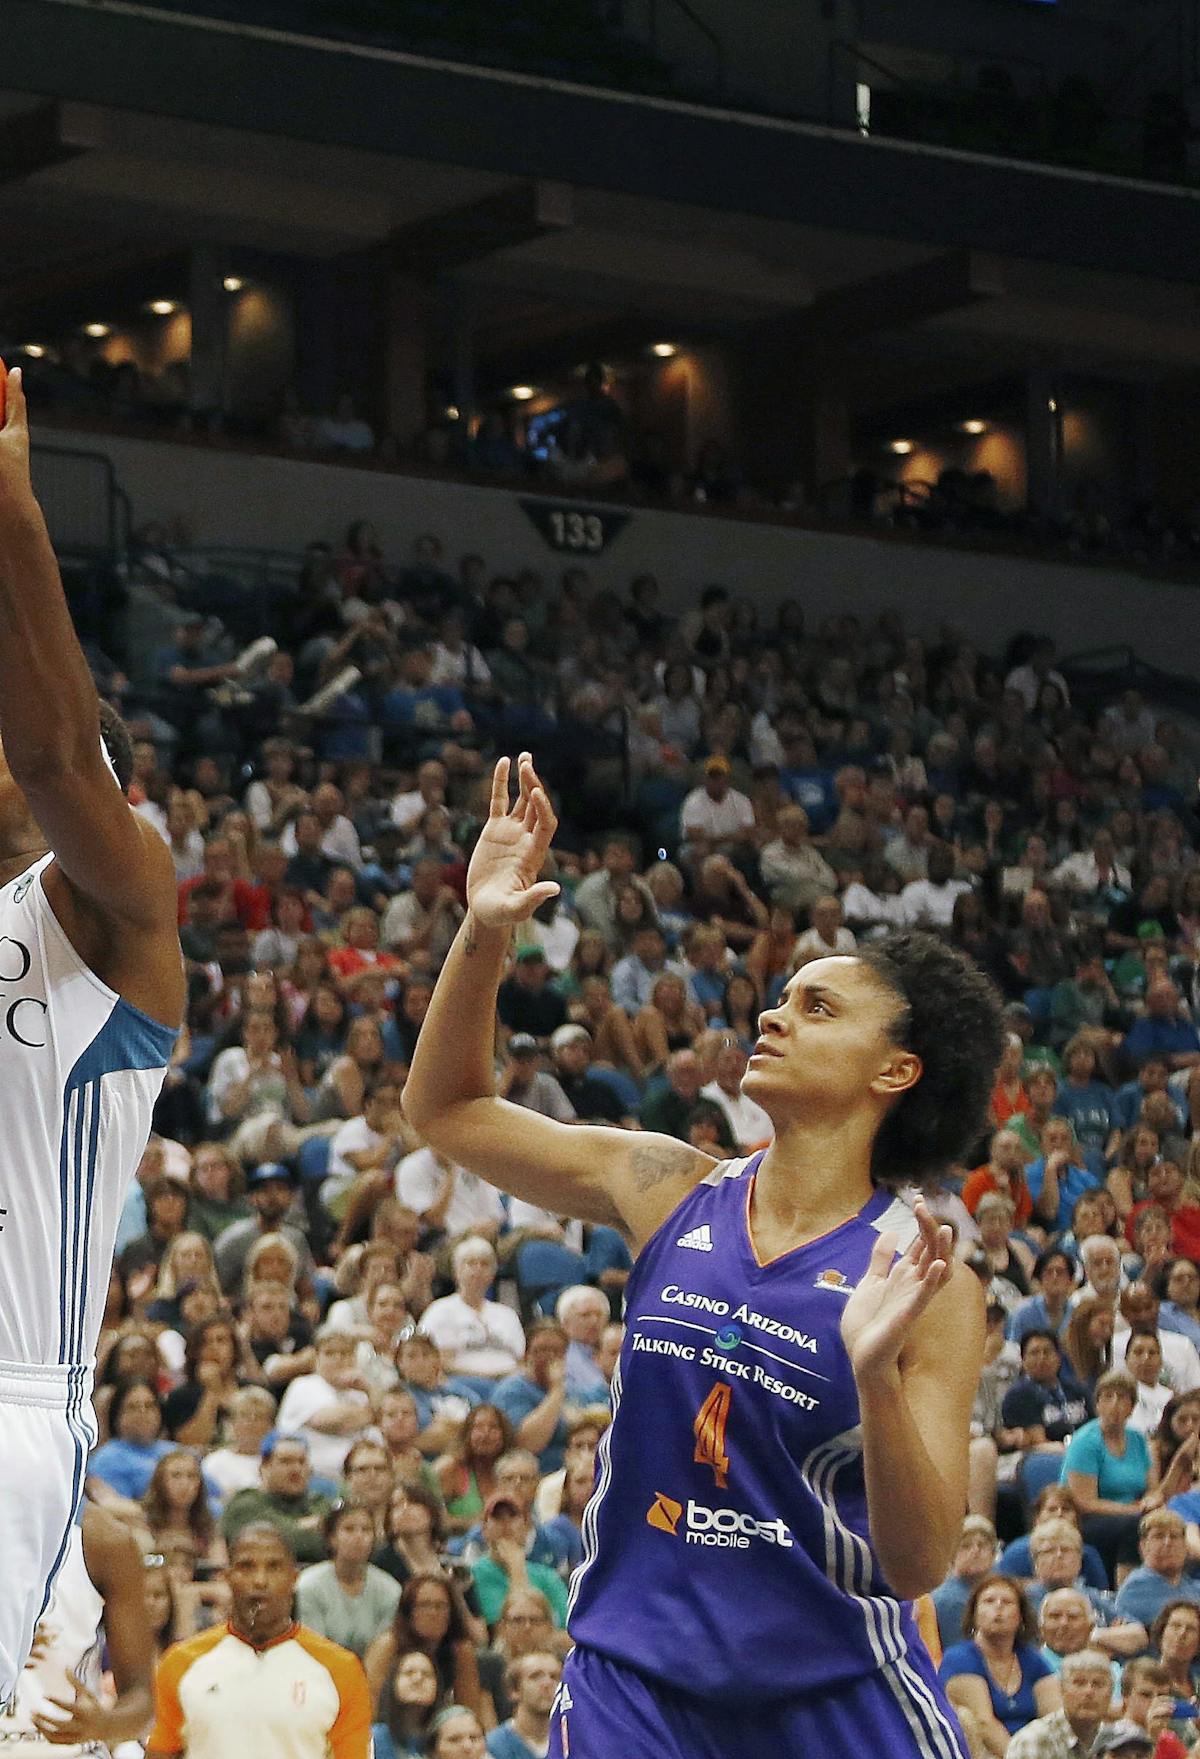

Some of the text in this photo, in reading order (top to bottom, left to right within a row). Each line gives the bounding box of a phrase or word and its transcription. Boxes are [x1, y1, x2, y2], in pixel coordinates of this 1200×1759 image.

[551, 511, 603, 548] 133
[661, 1284, 819, 1354] CASINO ARIZONA
[632, 1333, 696, 1361] TALKING
[700, 1347, 751, 1380] STICK
[693, 1382, 733, 1489] 4
[685, 1531, 750, 1549] mobile
[686, 1500, 793, 1547] boost
